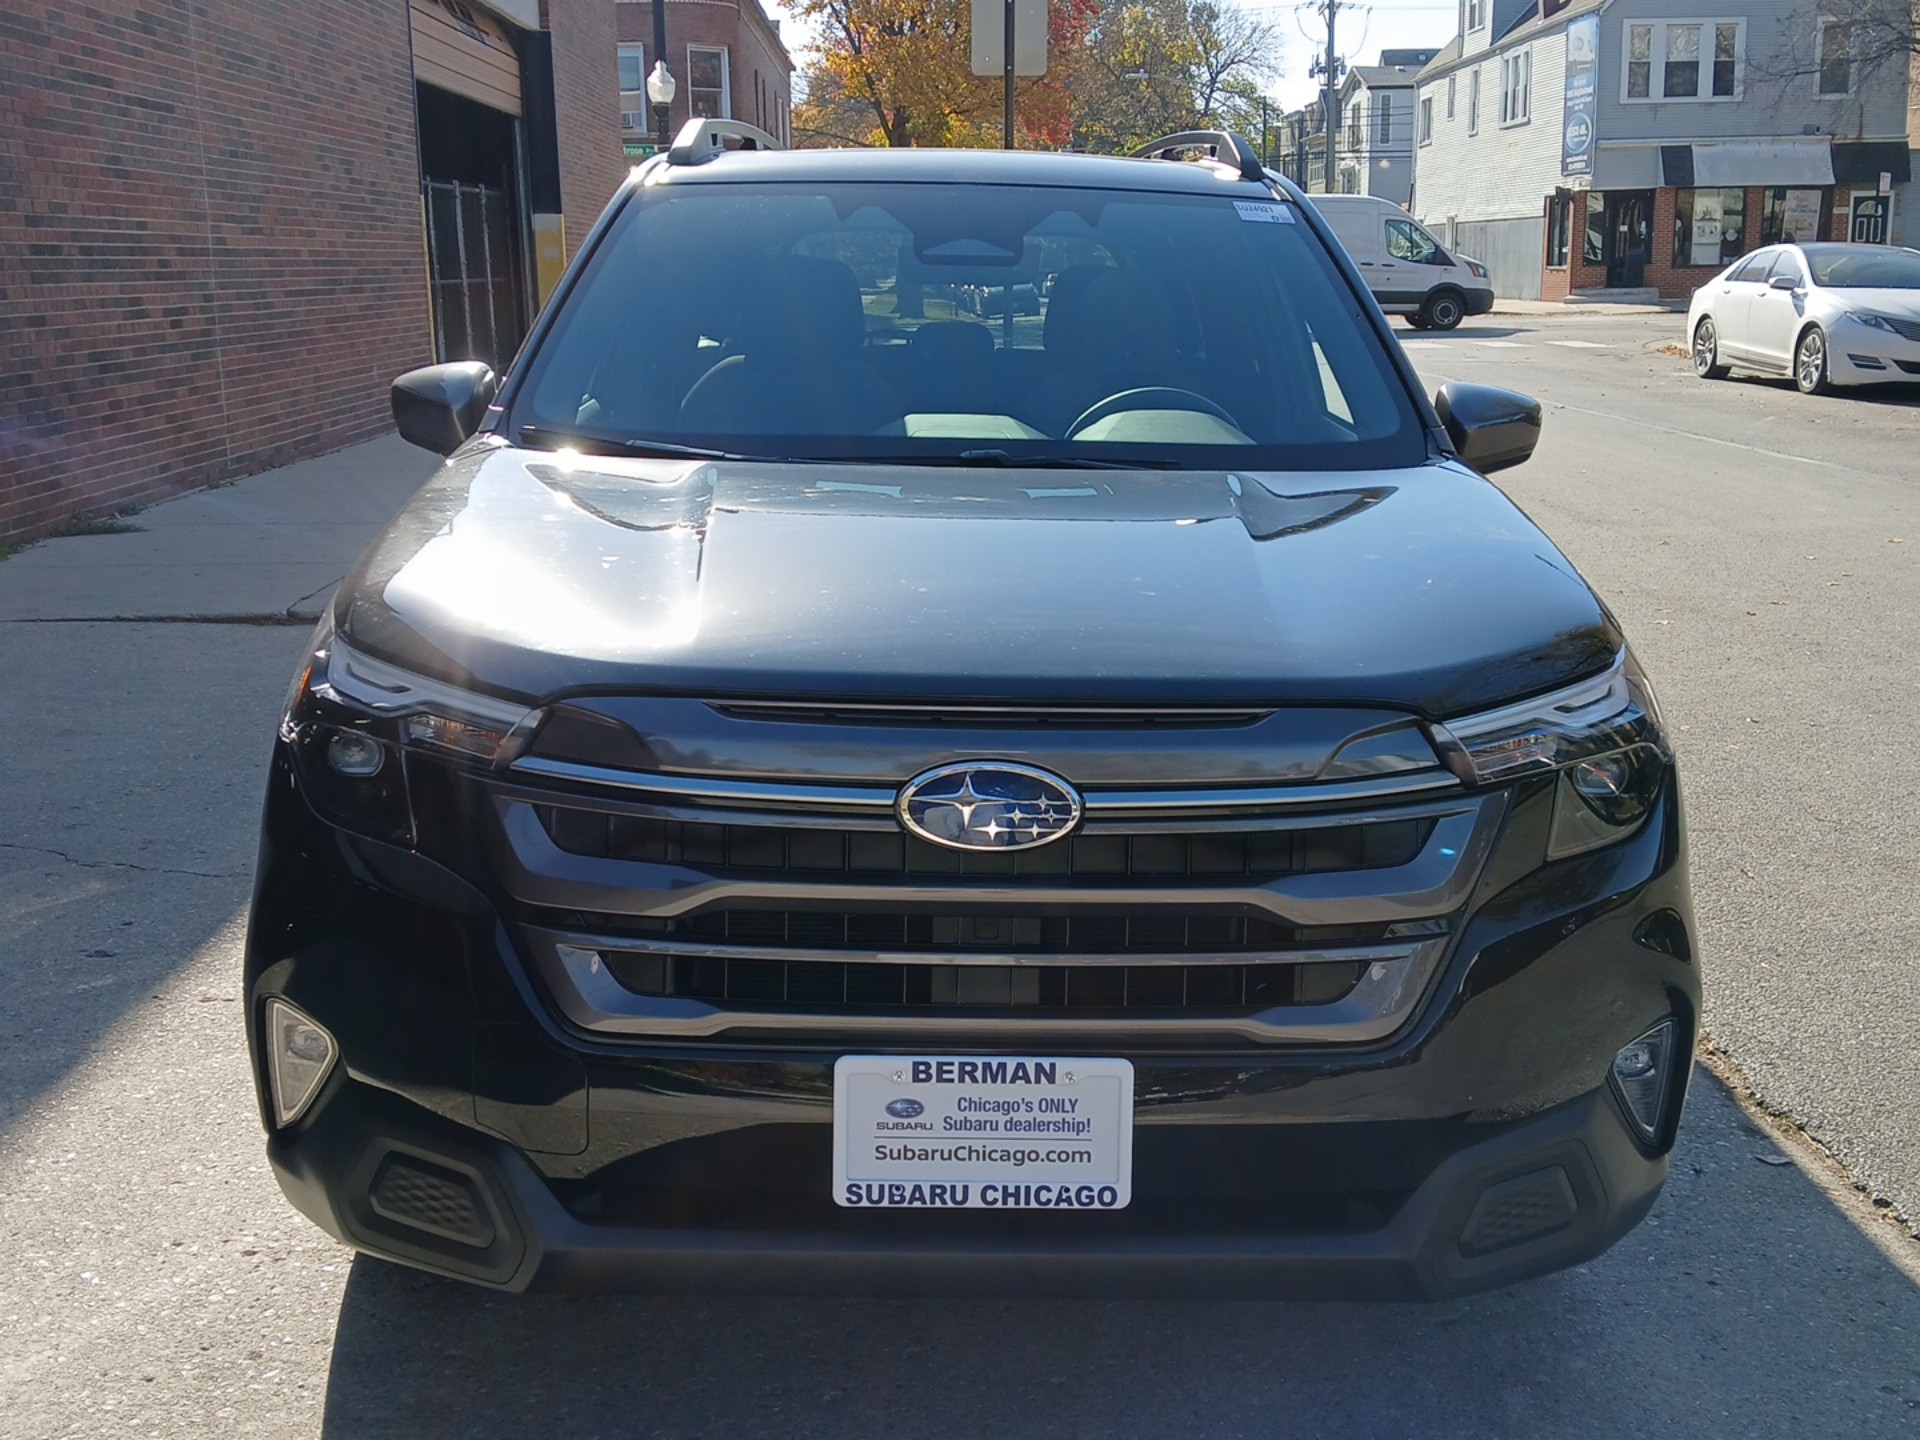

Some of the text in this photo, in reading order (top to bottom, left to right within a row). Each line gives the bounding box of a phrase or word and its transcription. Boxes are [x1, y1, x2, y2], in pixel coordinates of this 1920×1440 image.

[911, 1060, 1057, 1085] BERMAN
[957, 1097, 1079, 1116] Chicago's ONLY
[876, 1121, 933, 1131] SUBARU
[943, 1116, 1091, 1136] Subaru dealership!
[875, 1144, 1092, 1167] SubaruChicago.com
[845, 1183, 1118, 1208] SUBARU CHICAGO
